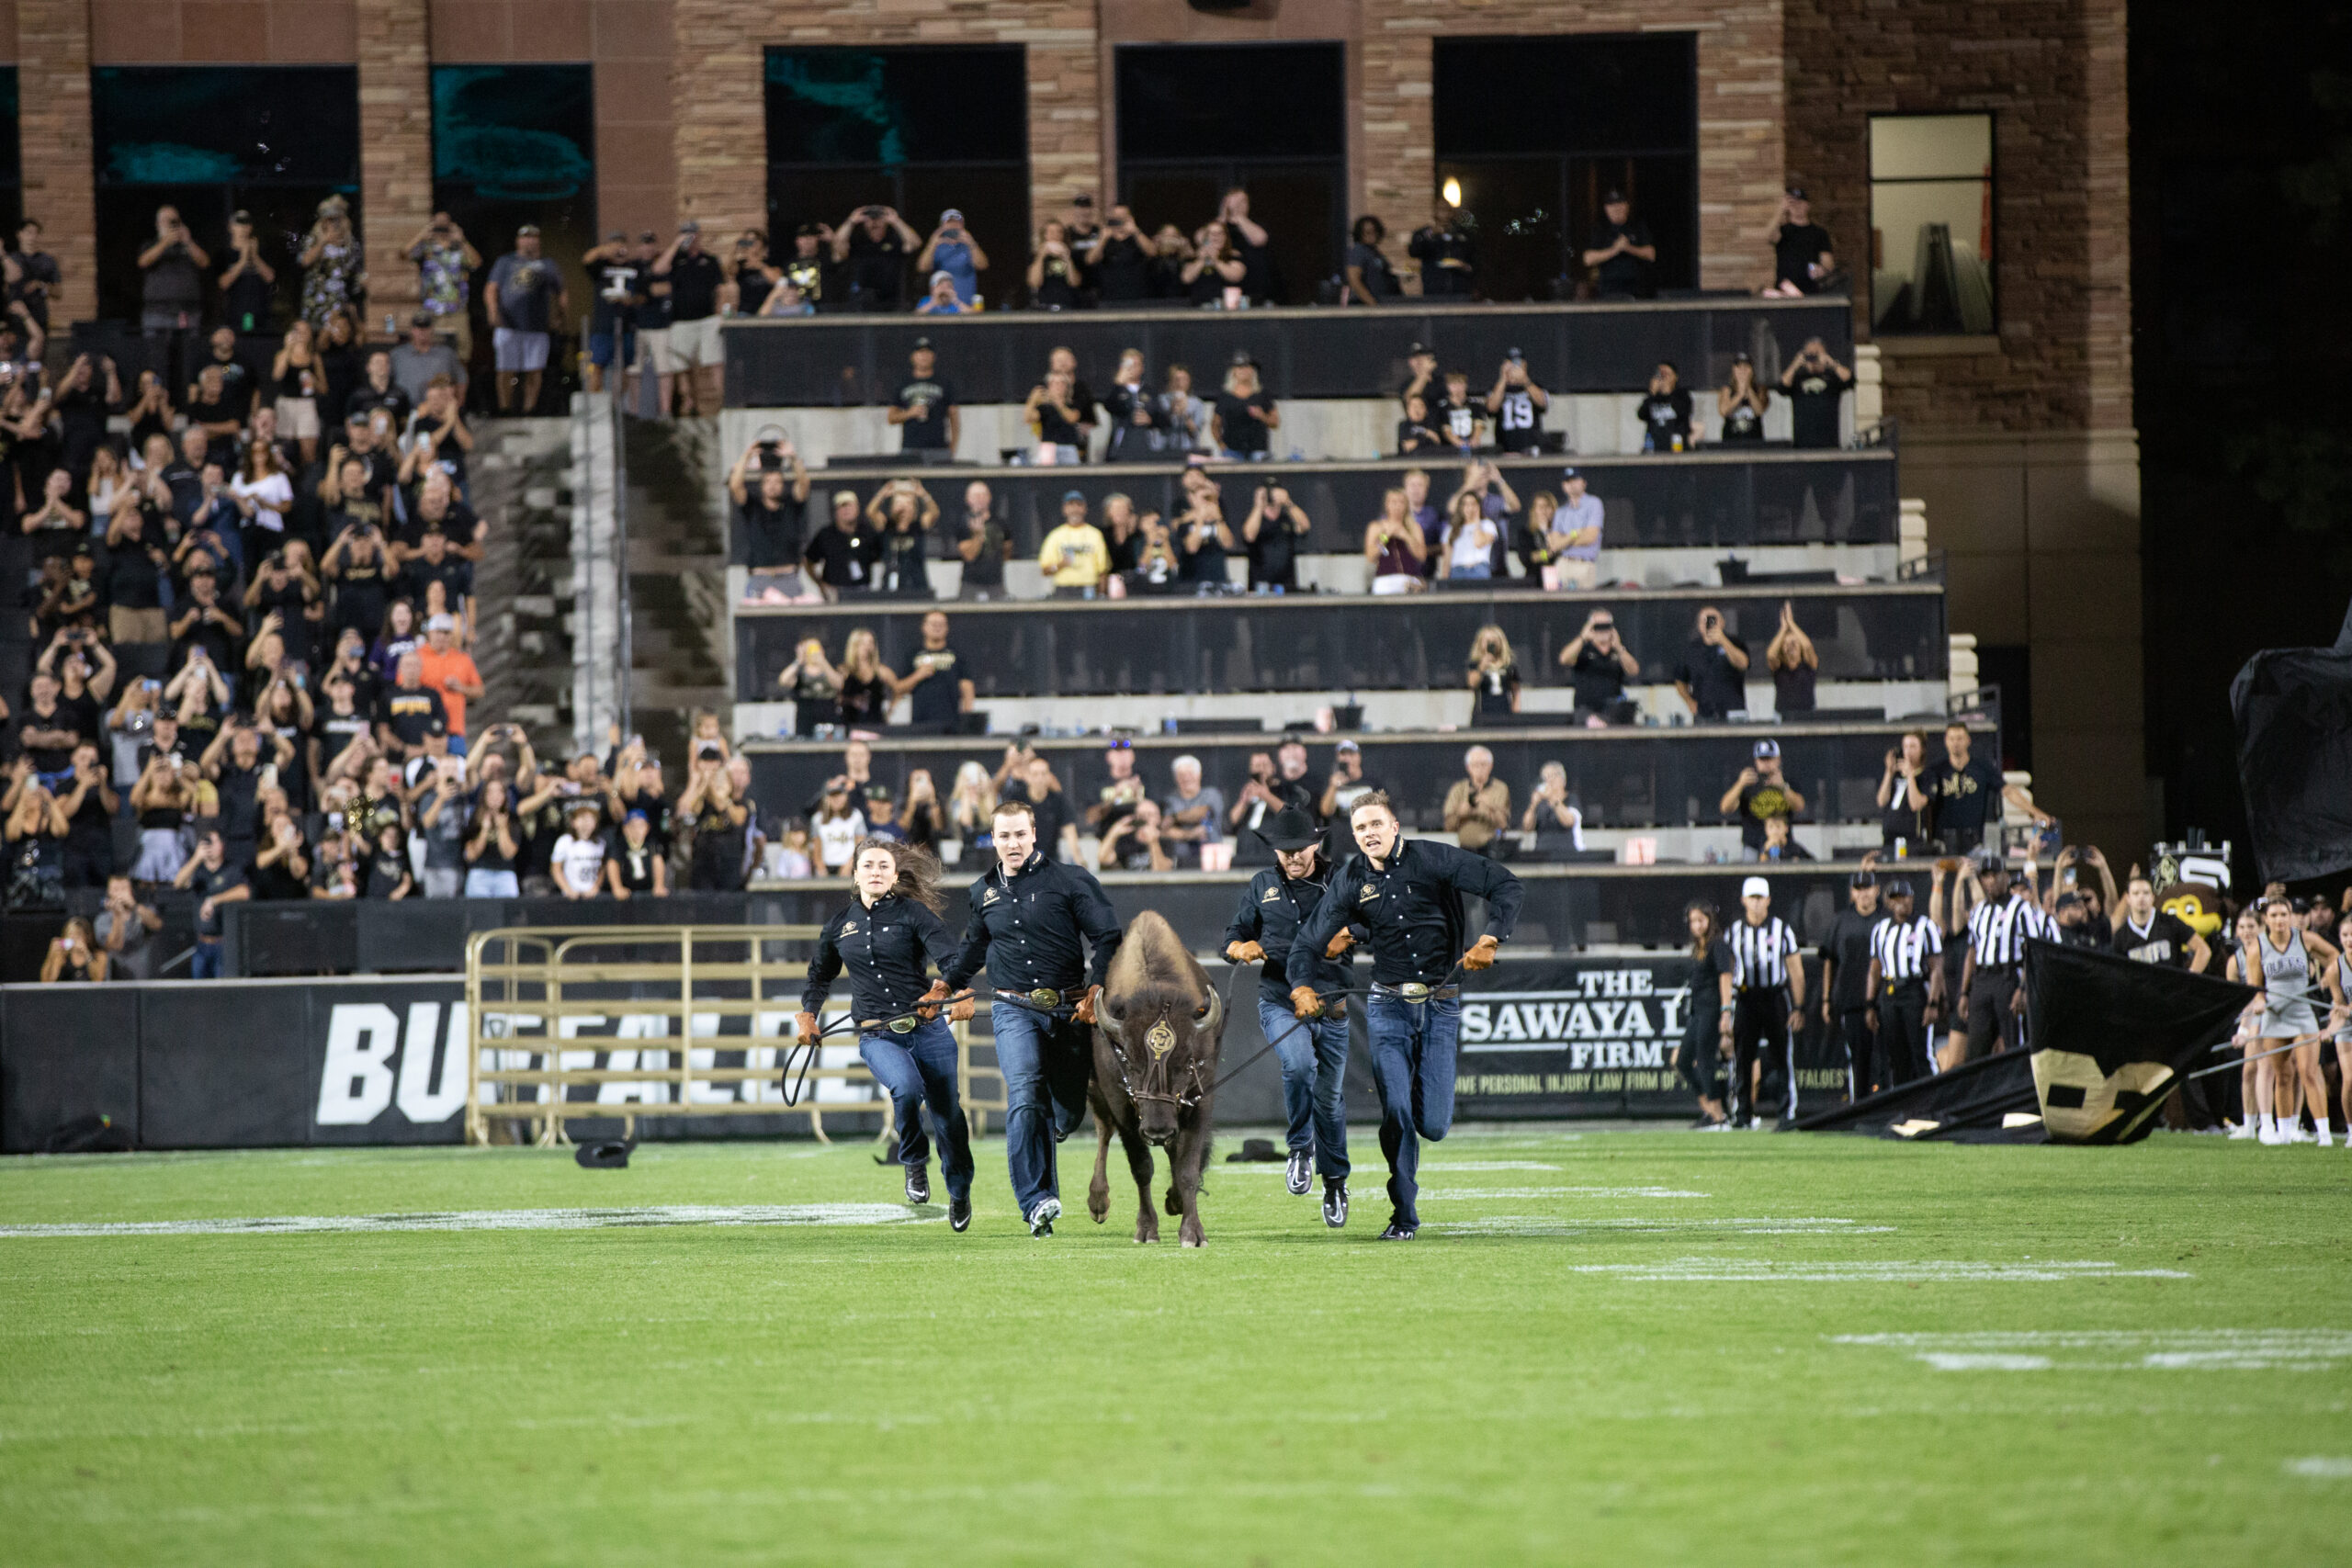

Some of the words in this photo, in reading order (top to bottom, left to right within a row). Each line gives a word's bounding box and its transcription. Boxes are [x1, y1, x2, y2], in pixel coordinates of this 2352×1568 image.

[1577, 969, 1653, 998] THE
[1460, 1000, 1655, 1042] SAWAYA
[316, 997, 923, 1125] BUFFALOE
[1570, 1042, 1664, 1070] FIRM
[1479, 1074, 1543, 1095] PERSONAL
[1546, 1072, 1591, 1092] INJURY
[1594, 1072, 1623, 1091] LAW
[1625, 1071, 1657, 1090] FIRM
[1660, 1070, 1677, 1090] OF
